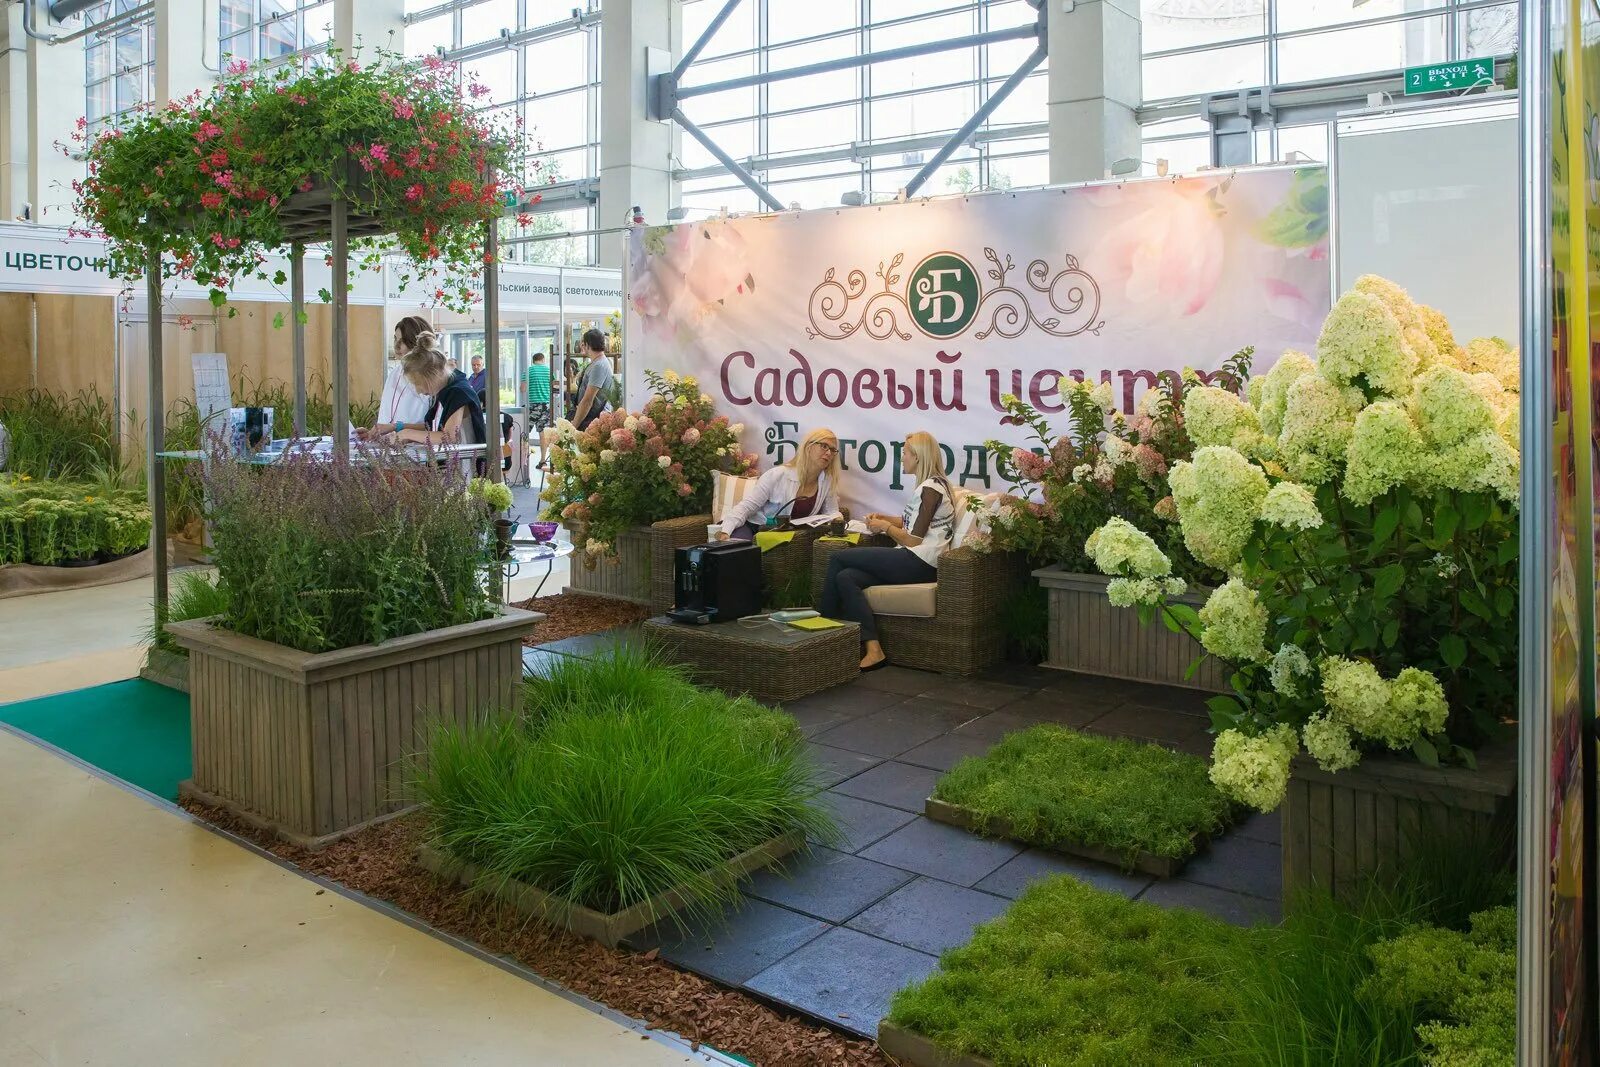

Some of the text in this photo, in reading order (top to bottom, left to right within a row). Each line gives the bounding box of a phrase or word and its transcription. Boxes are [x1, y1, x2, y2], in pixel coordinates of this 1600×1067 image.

[1428, 65, 1468, 76] ВЫХОД
[1429, 71, 1466, 81] EXIT
[1412, 74, 1420, 85] 2
[5, 251, 147, 275] ЦВЕТОЧН
[533, 284, 560, 295] завод
[916, 268, 965, 324] Б
[719, 348, 967, 413] Садовый
